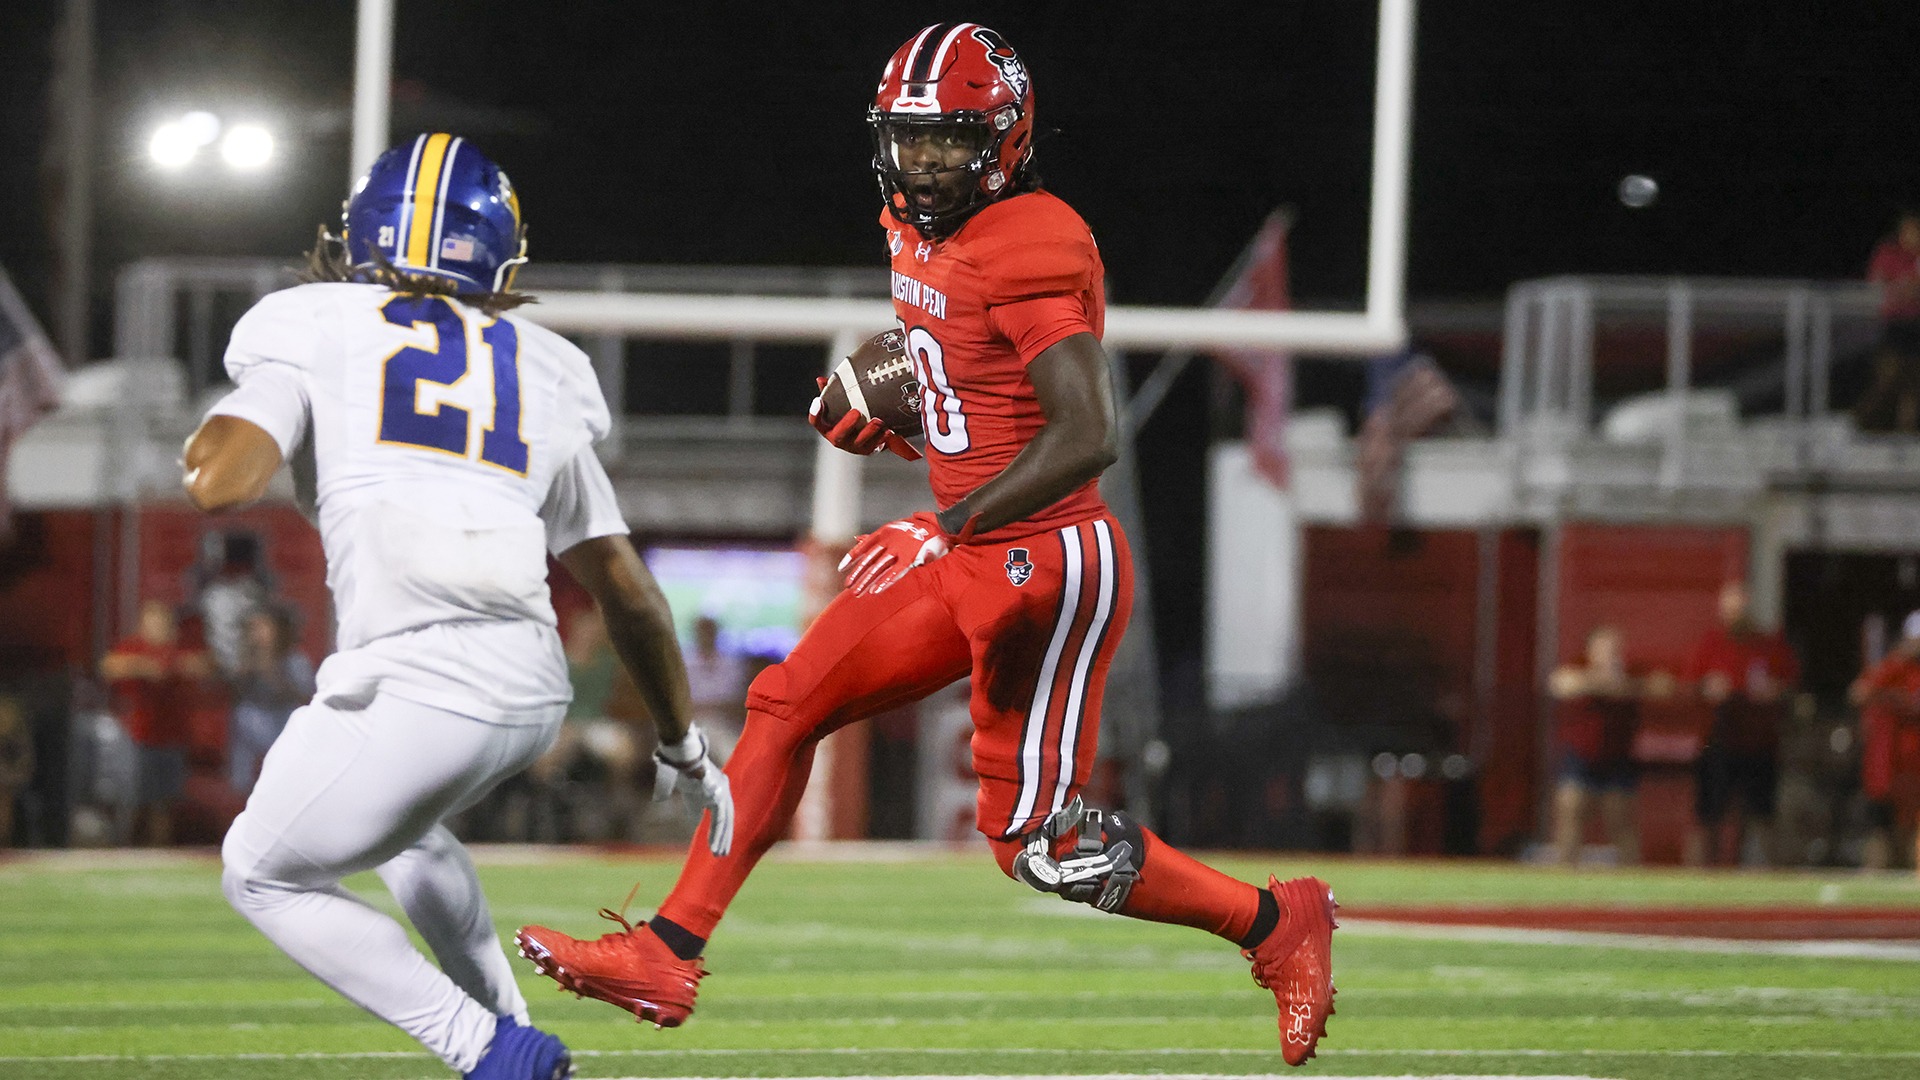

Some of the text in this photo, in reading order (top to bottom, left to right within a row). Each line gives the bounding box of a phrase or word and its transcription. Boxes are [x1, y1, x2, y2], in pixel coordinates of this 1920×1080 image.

[378, 225, 395, 247] 21
[922, 283, 948, 320] PEAY
[375, 291, 531, 478] 21
[896, 315, 971, 456] 0
